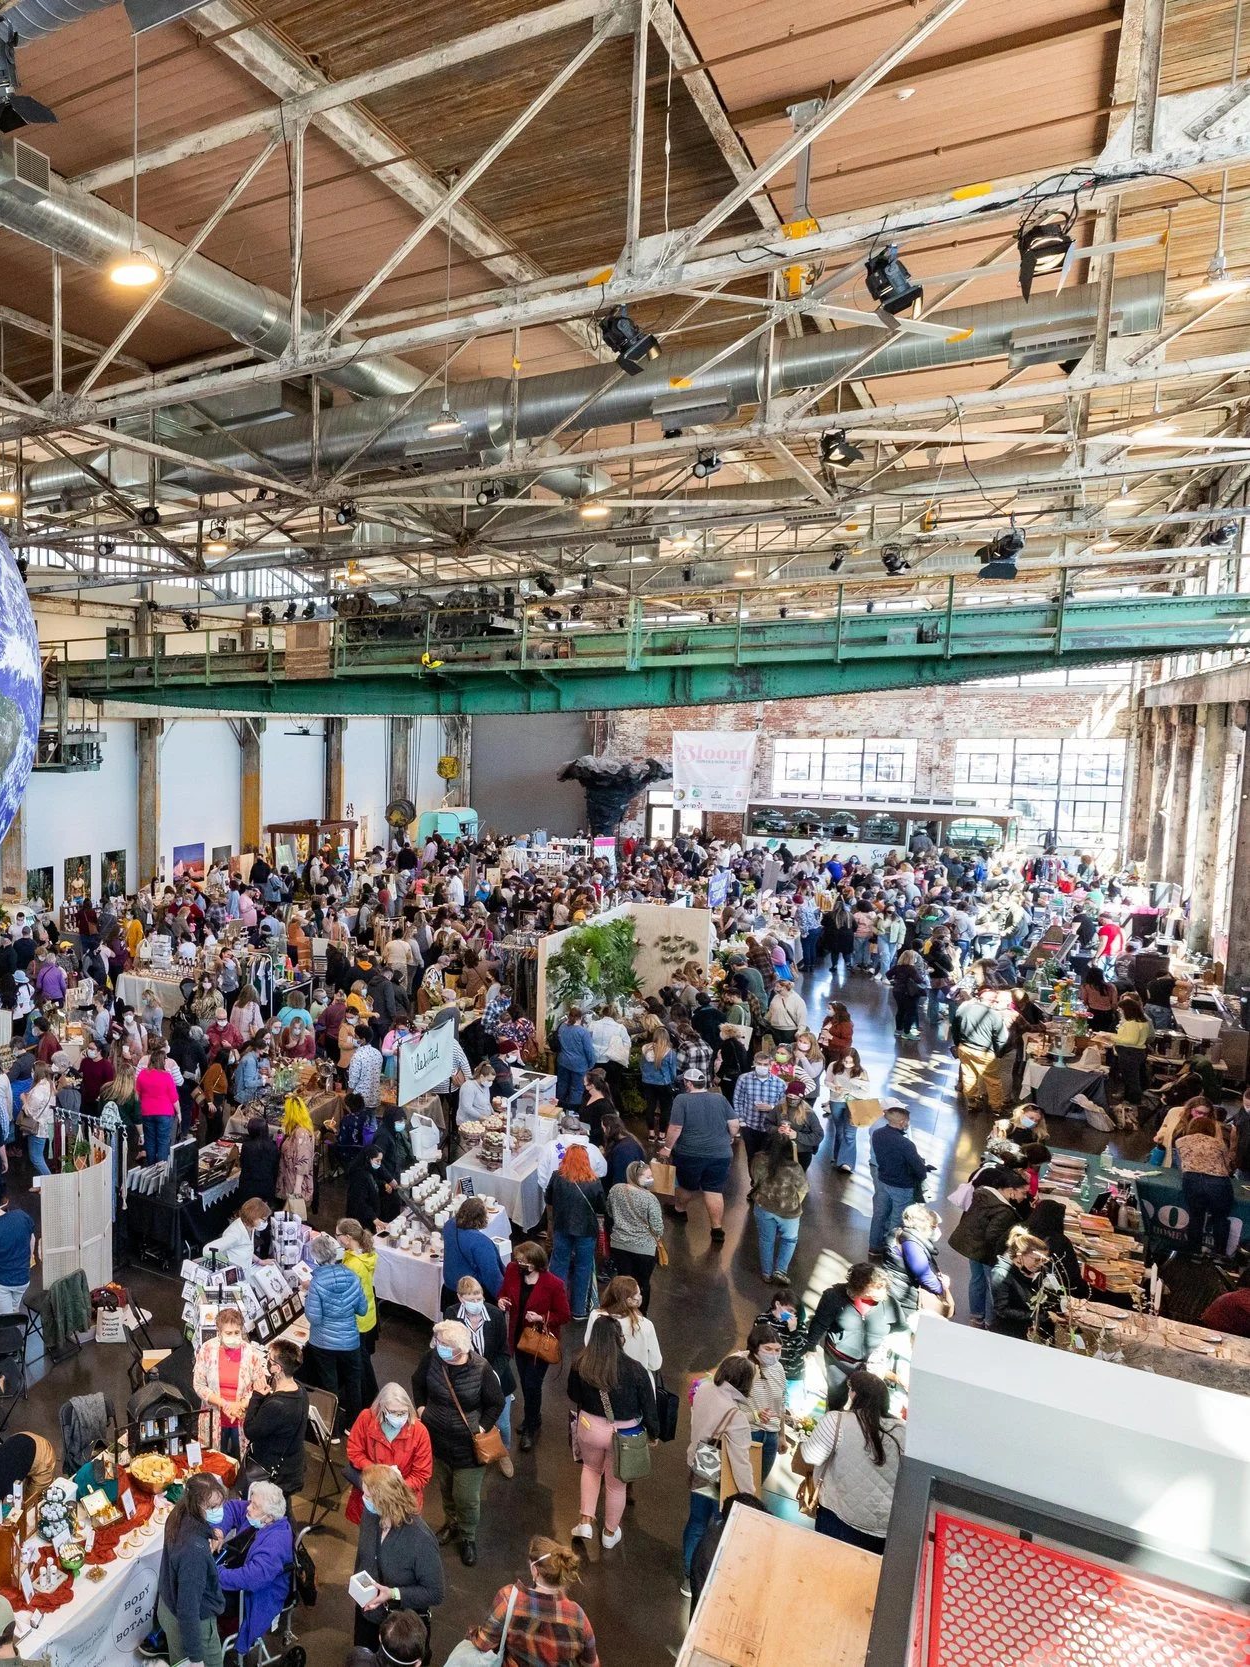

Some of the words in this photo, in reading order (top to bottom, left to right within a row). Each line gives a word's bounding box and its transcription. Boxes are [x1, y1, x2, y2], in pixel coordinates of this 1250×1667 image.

[676, 744, 749, 771] Bloom
[124, 1584, 151, 1612] BODY
[134, 1605, 143, 1616] &
[116, 1606, 155, 1643] BOTAN
